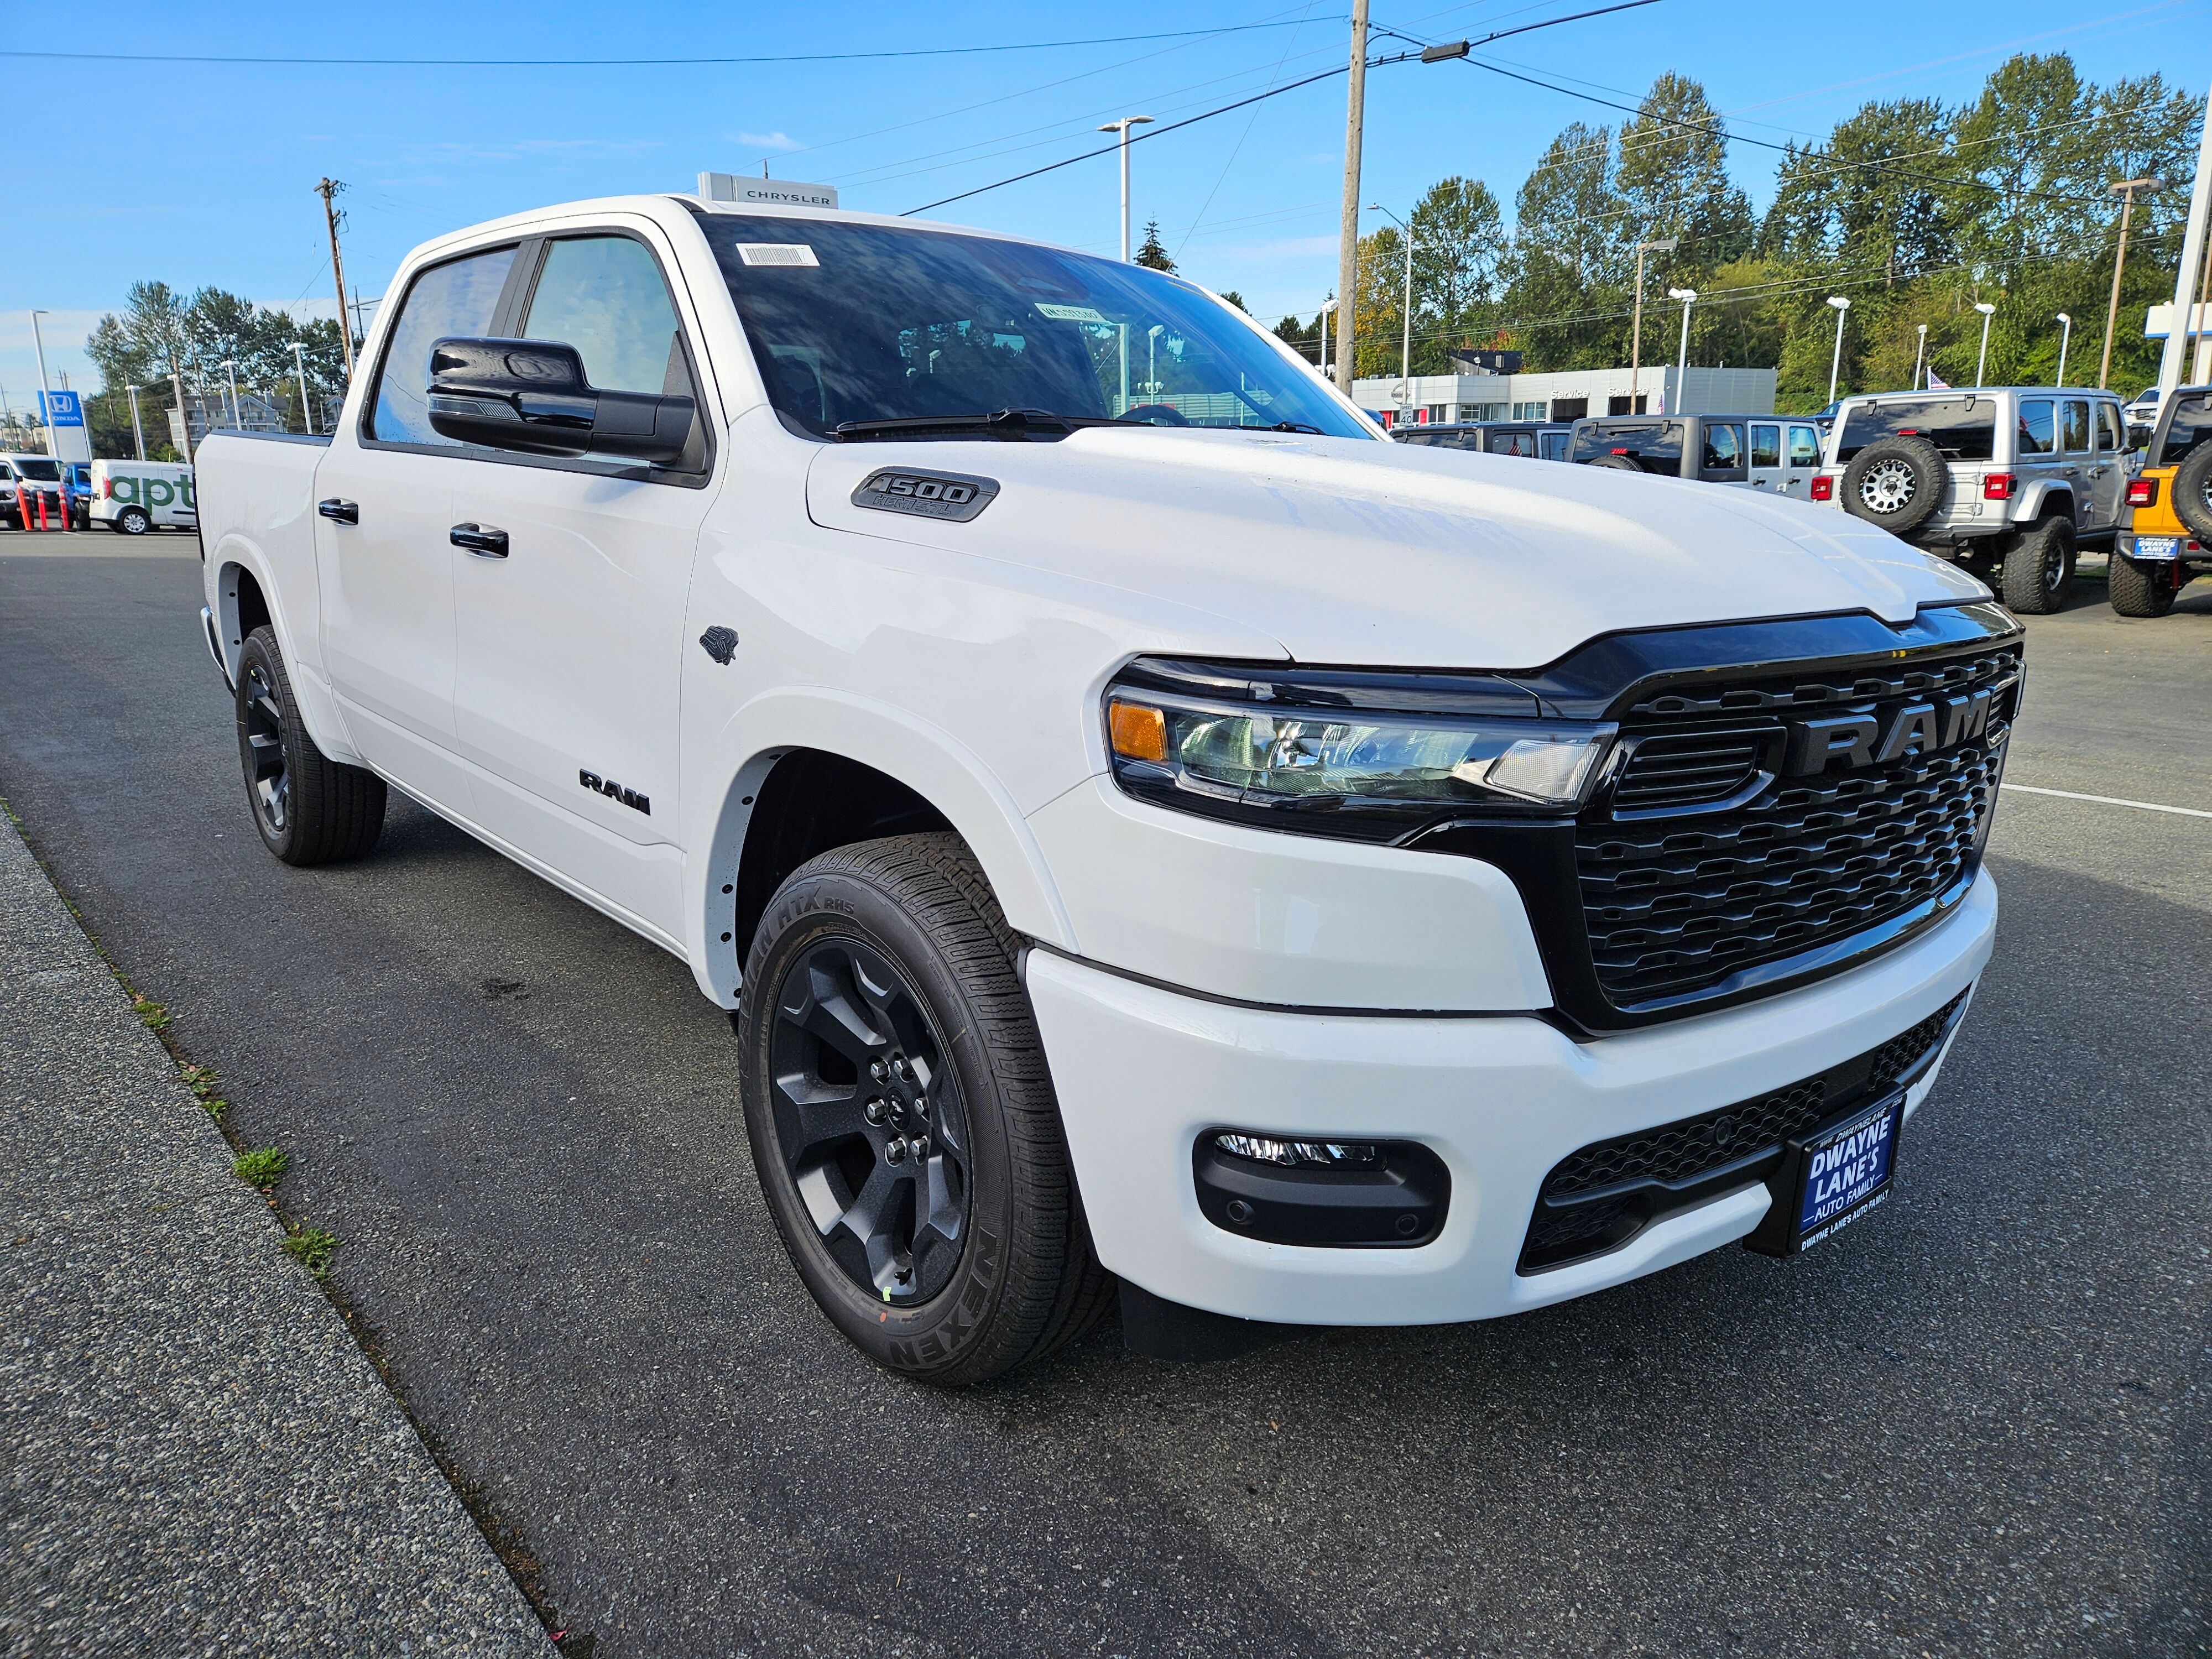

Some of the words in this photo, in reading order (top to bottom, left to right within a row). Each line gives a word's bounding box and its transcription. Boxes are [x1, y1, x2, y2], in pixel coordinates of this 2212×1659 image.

[747, 190, 830, 205] CHRYSLER
[1551, 389, 1590, 399] Service
[1608, 387, 1649, 397] Servce
[1401, 415, 1412, 424] 40
[872, 494, 915, 511] HEMI
[915, 500, 952, 517] 5.7L
[877, 476, 975, 504] 1500
[1795, 688, 1991, 778] RAM
[580, 768, 651, 816] RAM
[776, 885, 821, 930] HTX
[823, 896, 855, 915] RH5
[1810, 1114, 1891, 1180] DWAYNE
[1835, 1107, 1887, 1142] DWAYNELANE
[1814, 1146, 1880, 1204] LANE'S
[1801, 1227, 1829, 1252] DWAYNE
[1830, 1214, 1852, 1233] LANE'S
[1852, 1203, 1868, 1221] AUTO
[1867, 1188, 1890, 1211] FAMILY
[1814, 1196, 1844, 1223] AUTO
[1846, 1174, 1875, 1206] FAMILY
[888, 1225, 998, 1366] NEXEN
